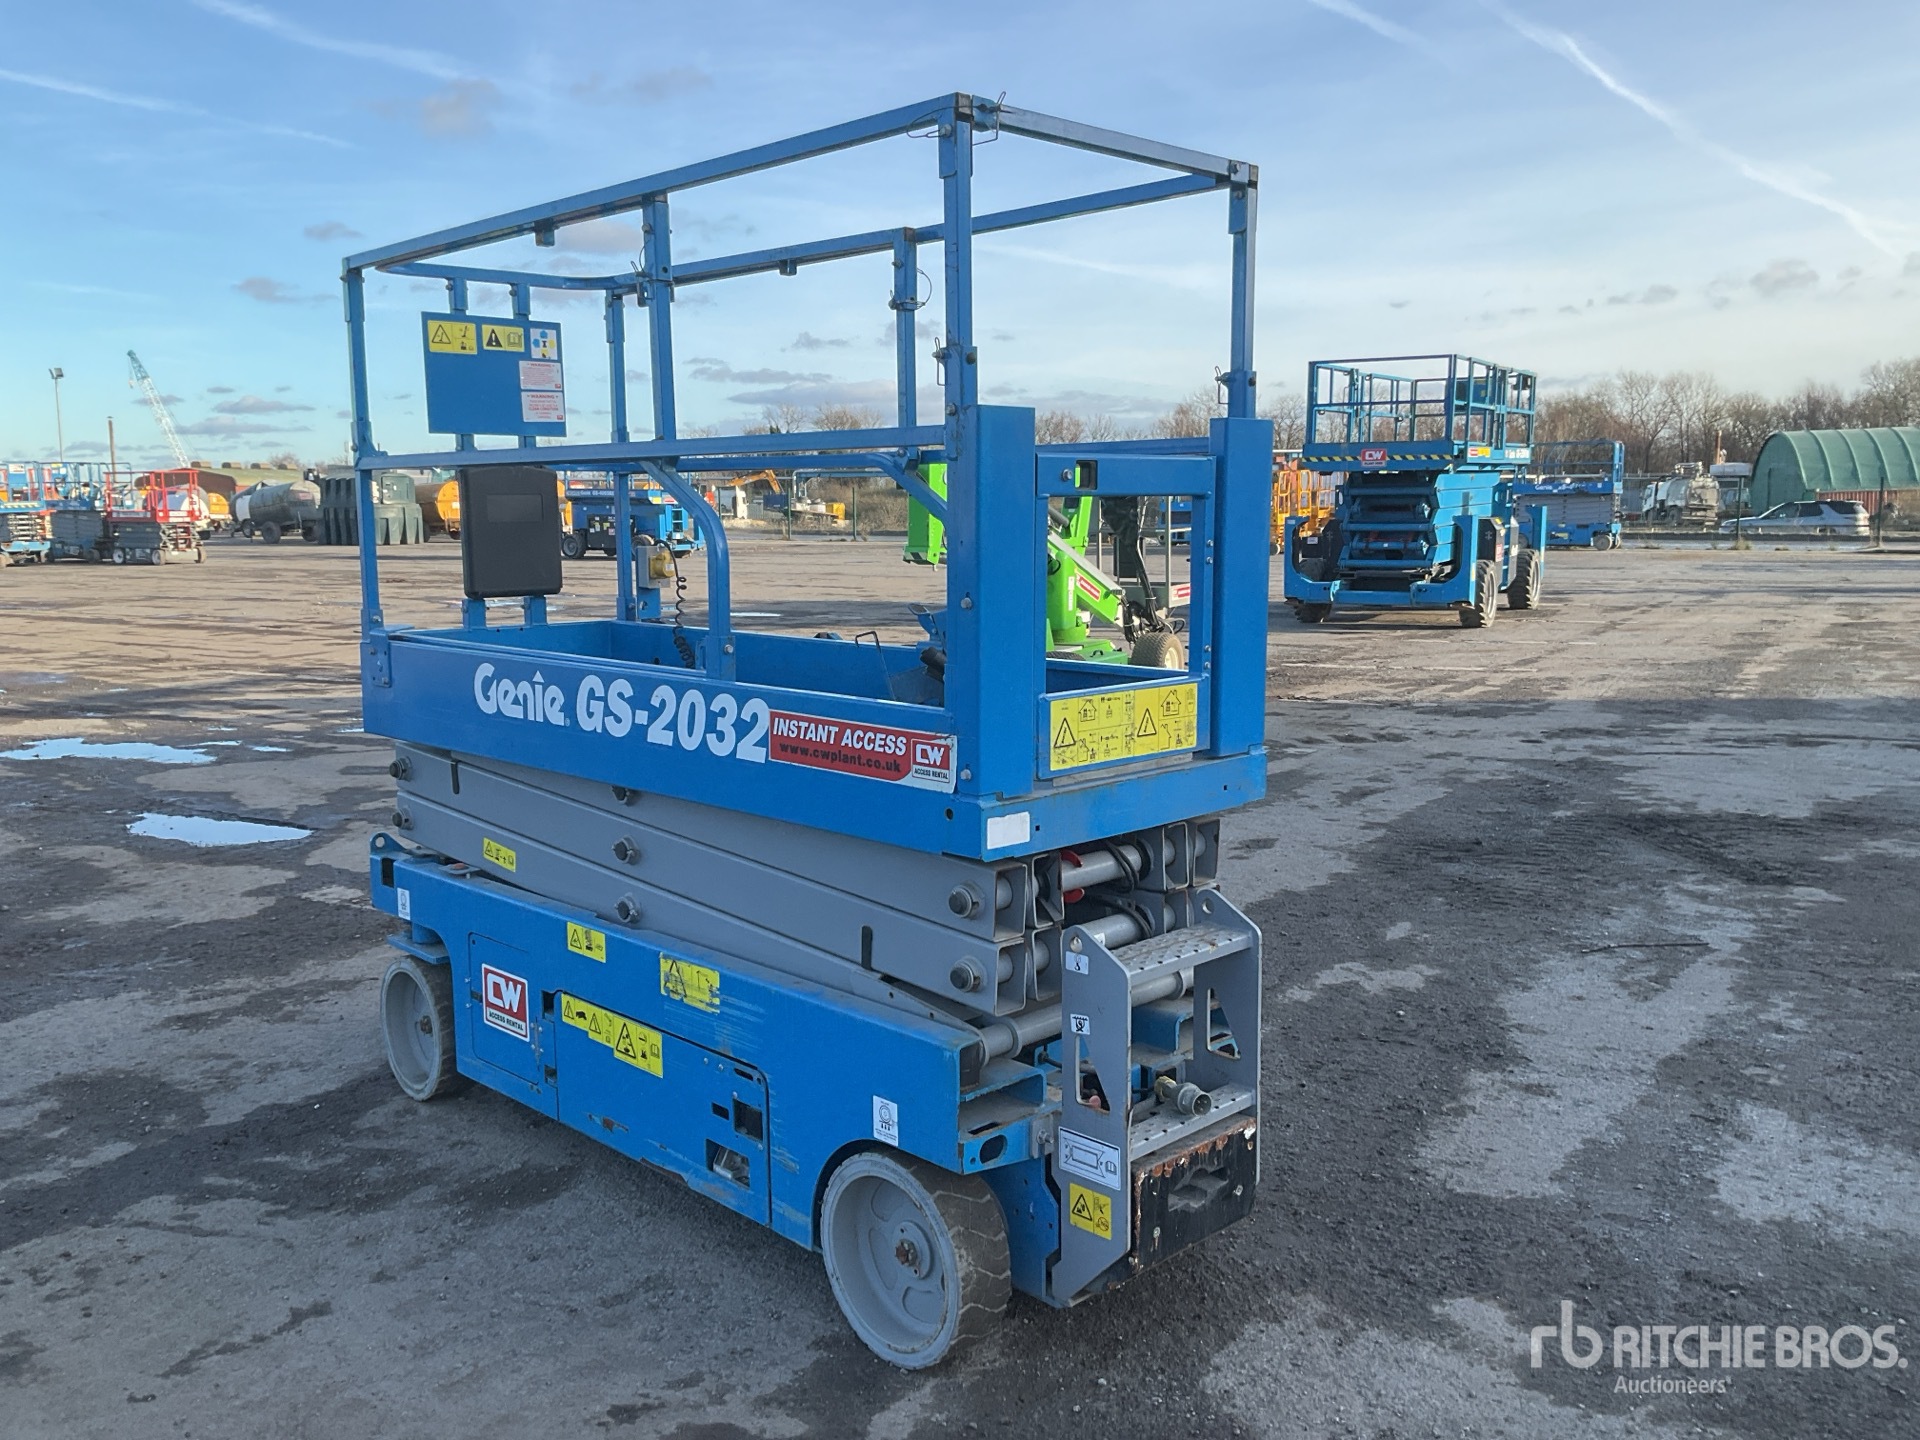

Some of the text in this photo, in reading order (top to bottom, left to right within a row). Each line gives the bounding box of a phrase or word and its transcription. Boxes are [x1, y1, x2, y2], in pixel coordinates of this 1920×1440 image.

[1365, 450, 1384, 460] CW
[474, 662, 770, 764] Genie GS-2032
[773, 717, 907, 756] INSTANT ACCESS
[779, 741, 902, 773] www.cwplant.co.uk
[915, 743, 945, 766] CW
[914, 767, 949, 780] ACCESS RENTAL
[487, 972, 522, 1013] CW
[488, 1010, 523, 1031] ACCESS RENTAL
